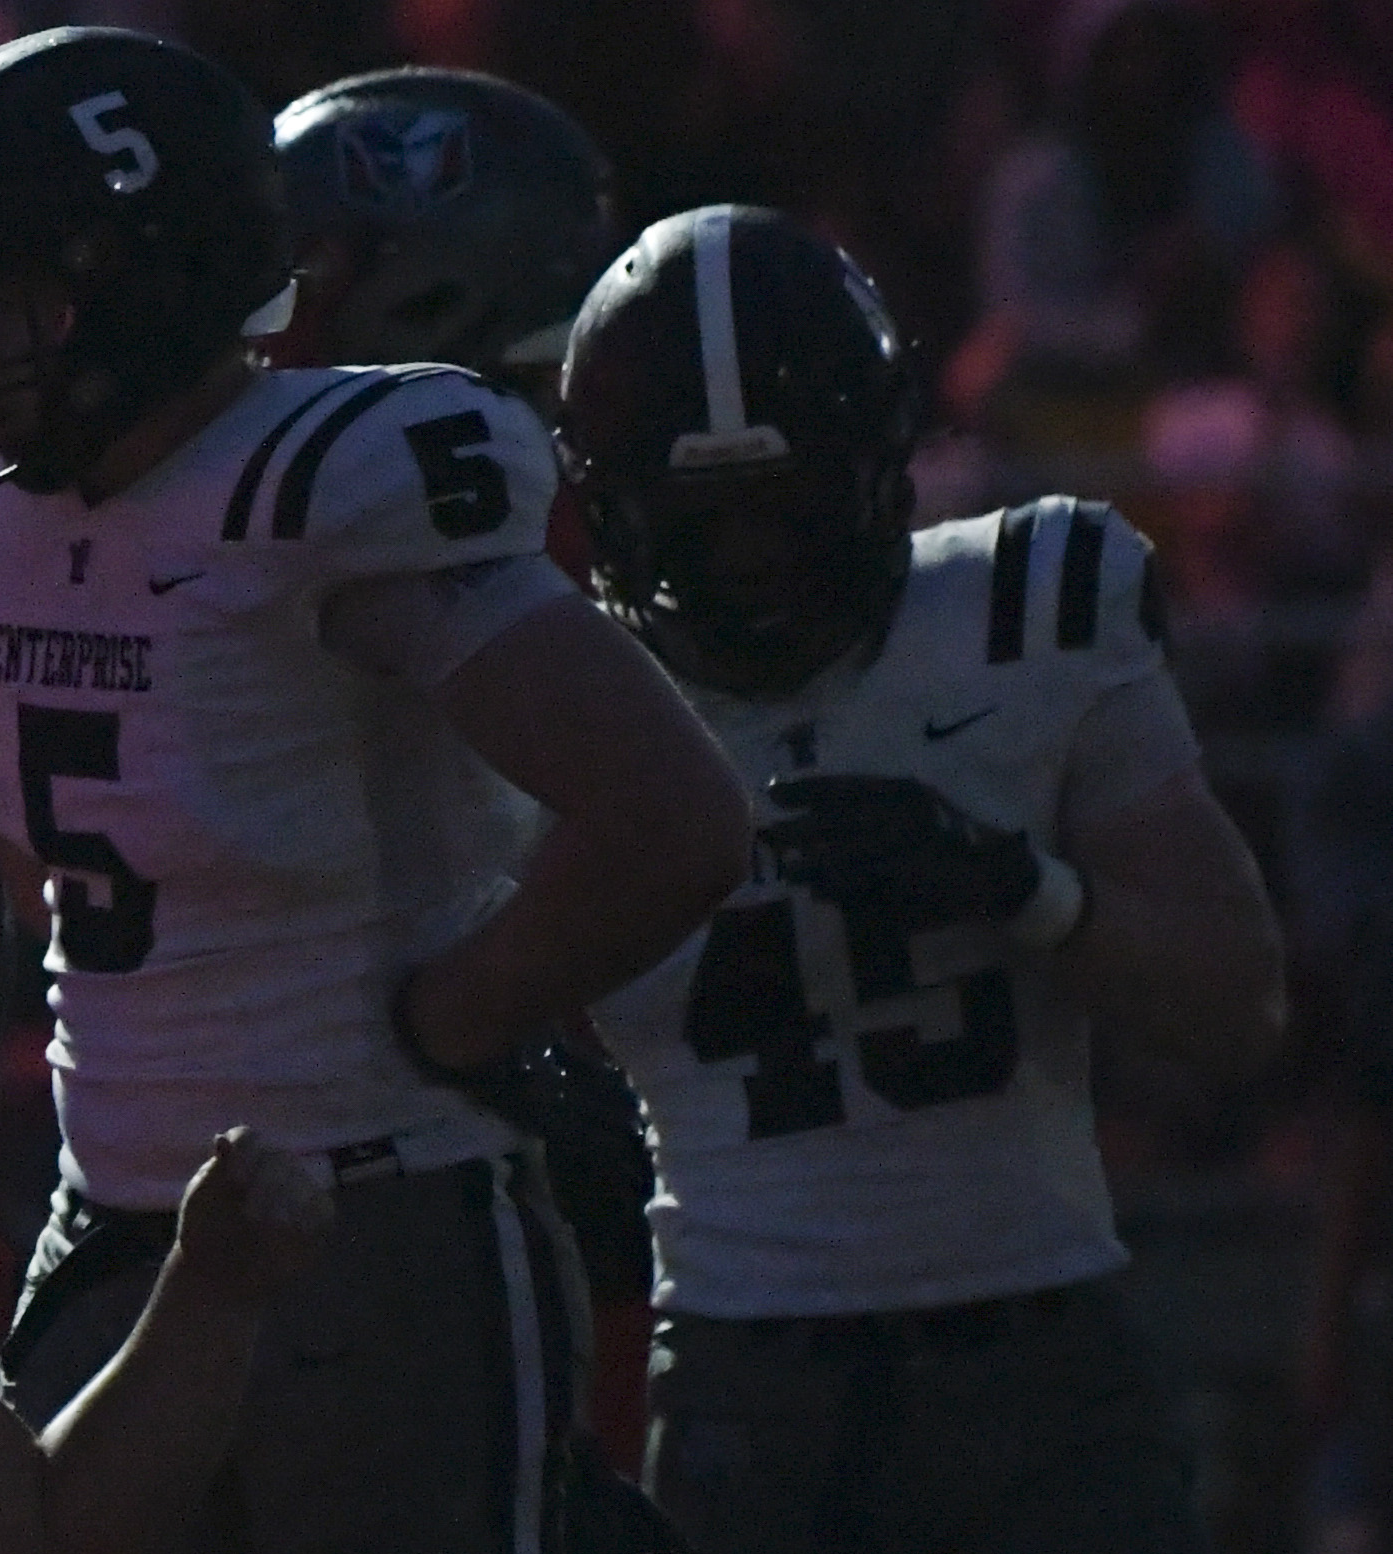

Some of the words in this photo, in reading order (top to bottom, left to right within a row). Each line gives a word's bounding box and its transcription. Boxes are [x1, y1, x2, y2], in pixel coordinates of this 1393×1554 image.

[68, 90, 160, 194] 5
[404, 410, 512, 541] 5
[19, 702, 158, 974] 5
[683, 888, 1019, 1141] 45
